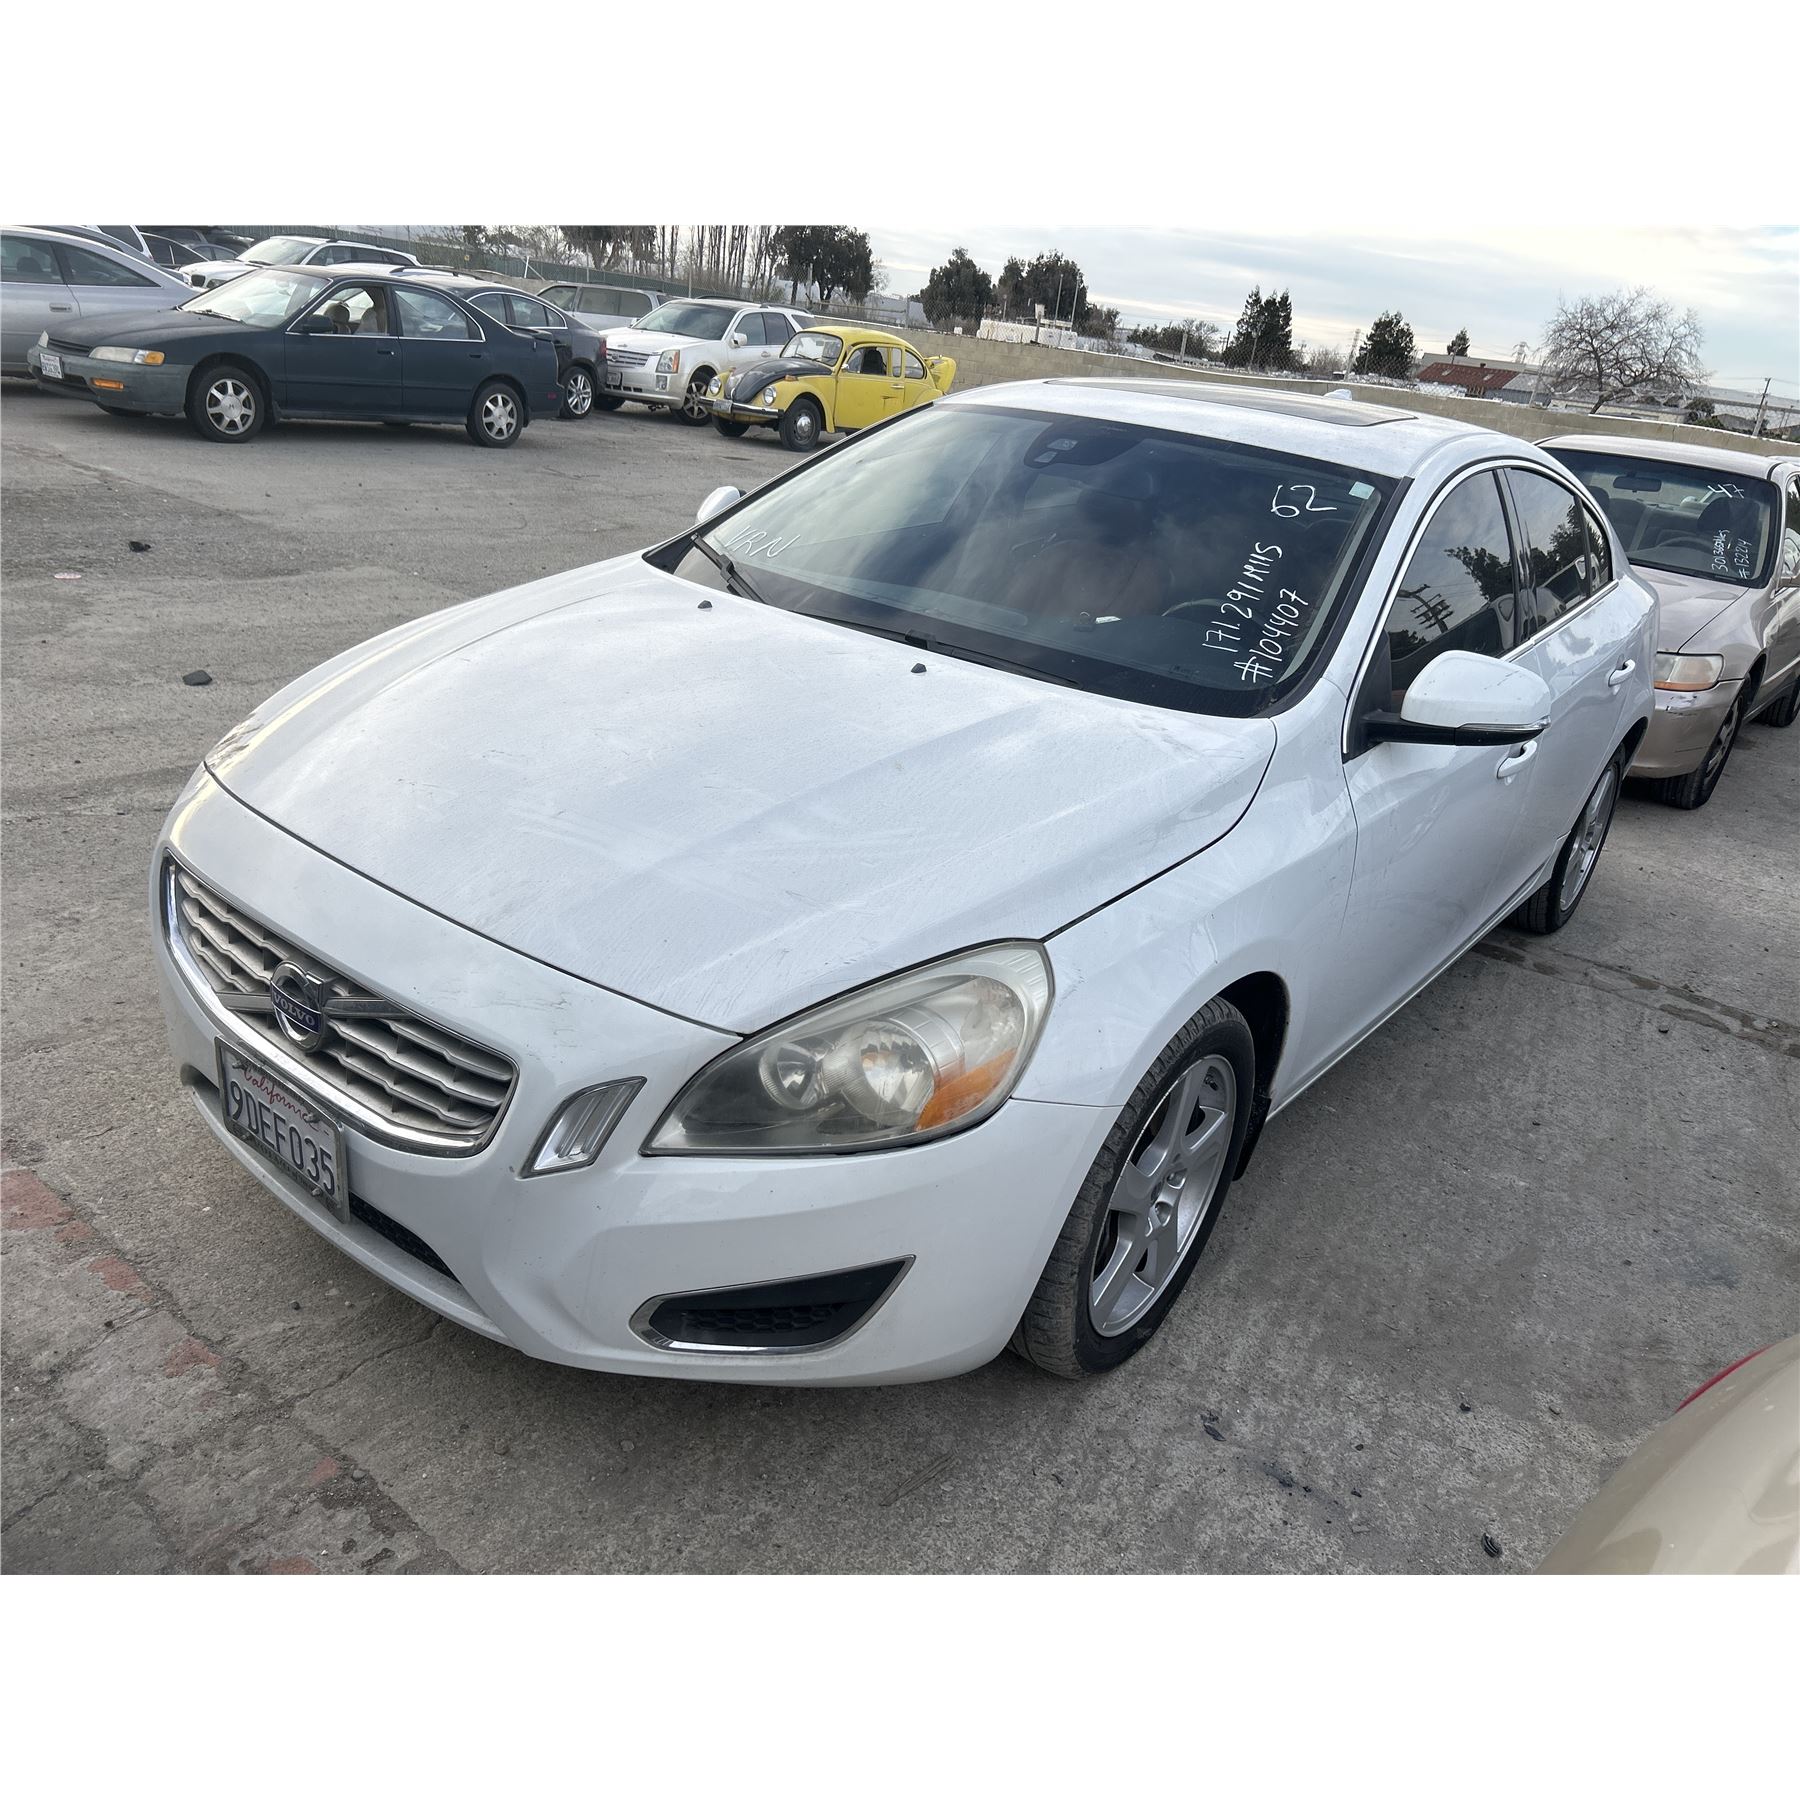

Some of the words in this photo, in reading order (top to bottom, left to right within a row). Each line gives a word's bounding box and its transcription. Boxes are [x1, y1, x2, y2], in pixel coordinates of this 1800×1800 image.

[1270, 484, 1338, 519] 62
[1707, 483, 1744, 499] 47
[1233, 588, 1309, 684] #104407
[272, 990, 316, 1027] VOLVO
[230, 1080, 335, 1197] 9DEF035
